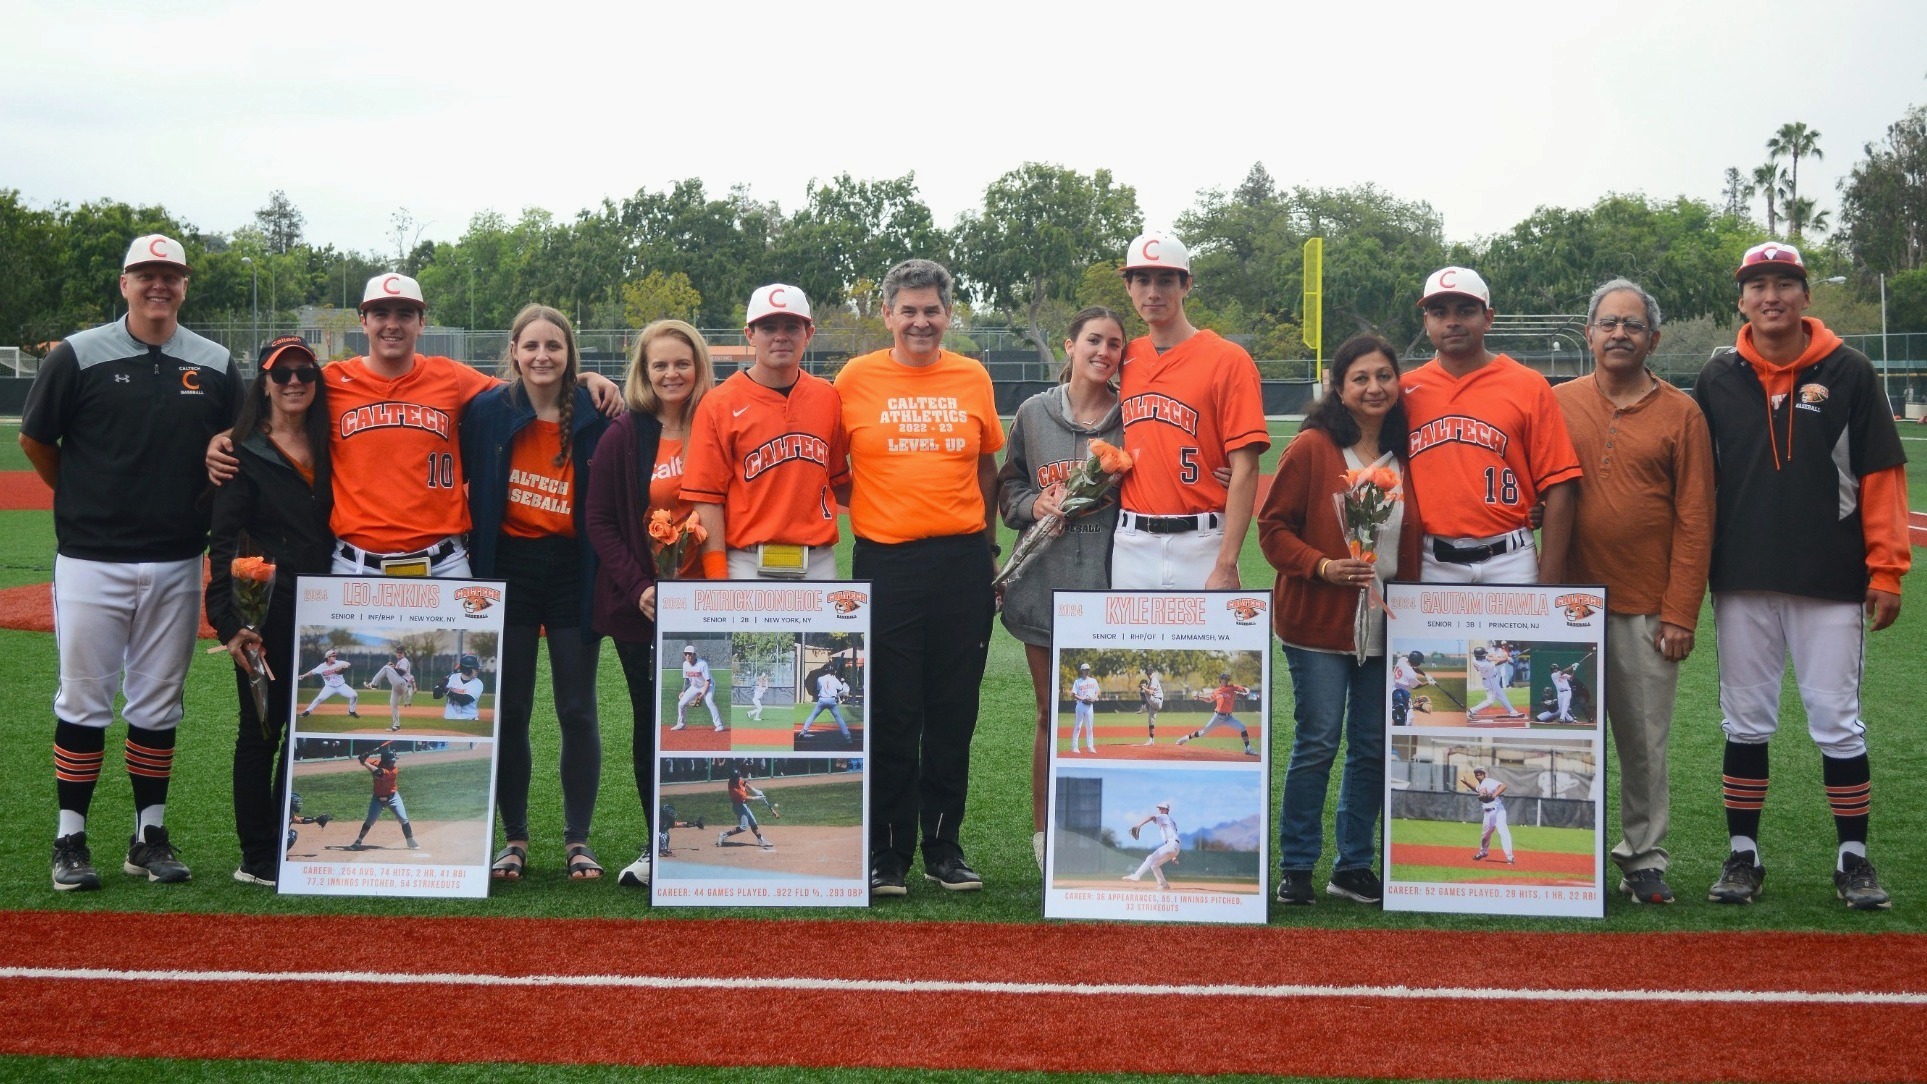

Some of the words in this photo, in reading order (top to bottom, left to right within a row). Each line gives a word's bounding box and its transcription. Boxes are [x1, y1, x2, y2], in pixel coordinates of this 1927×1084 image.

[150, 239, 167, 257] C
[1142, 240, 1160, 260] C
[383, 276, 400, 294] C
[1440, 270, 1456, 288] C
[768, 288, 786, 308] C
[272, 336, 301, 347] Caltech
[182, 370, 200, 390] C
[888, 397, 957, 410] CALTECH
[340, 401, 449, 442] CALTECH
[880, 410, 968, 423] ATHLETICS
[1120, 392, 1198, 438] ALTECH
[898, 424, 927, 432] 2022
[939, 423, 953, 432] 23
[1408, 414, 1508, 460] CALTECH
[888, 438, 940, 452] LEVEL
[945, 438, 966, 452] UP
[744, 432, 829, 482] CALTECH
[1180, 446, 1199, 484] 5
[427, 452, 454, 488] 10
[509, 469, 568, 496] ALTECH
[1484, 466, 1519, 506] 18
[508, 488, 570, 514] SEBALL
[820, 485, 832, 519] 1
[343, 582, 370, 606] LEO
[373, 583, 440, 608] JENKINS
[694, 590, 754, 611] PATRICK
[755, 590, 822, 612] DONOHOE
[1421, 592, 1483, 614] GAUTAM
[1486, 593, 1549, 615] CHAWLA
[1058, 604, 1083, 616] 2024
[1106, 597, 1148, 624] KYLE
[1151, 597, 1205, 624] REESE
[380, 868, 390, 876] 74
[416, 869, 421, 877] 2
[453, 870, 466, 878] RBI
[328, 878, 359, 886] INNINGS
[413, 880, 461, 889] STRIKEOUTS
[657, 888, 690, 896] CAREER:
[694, 888, 704, 896] 44
[707, 888, 734, 896] GAMES
[774, 888, 792, 896] .922
[795, 888, 809, 896] FLD
[826, 888, 844, 897] .293
[848, 888, 862, 896] OBP
[1388, 886, 1421, 895] CAREER:
[1426, 887, 1435, 895] 52
[1439, 888, 1465, 896] GAMES
[1569, 892, 1579, 900] 22
[1583, 892, 1596, 900] RBI
